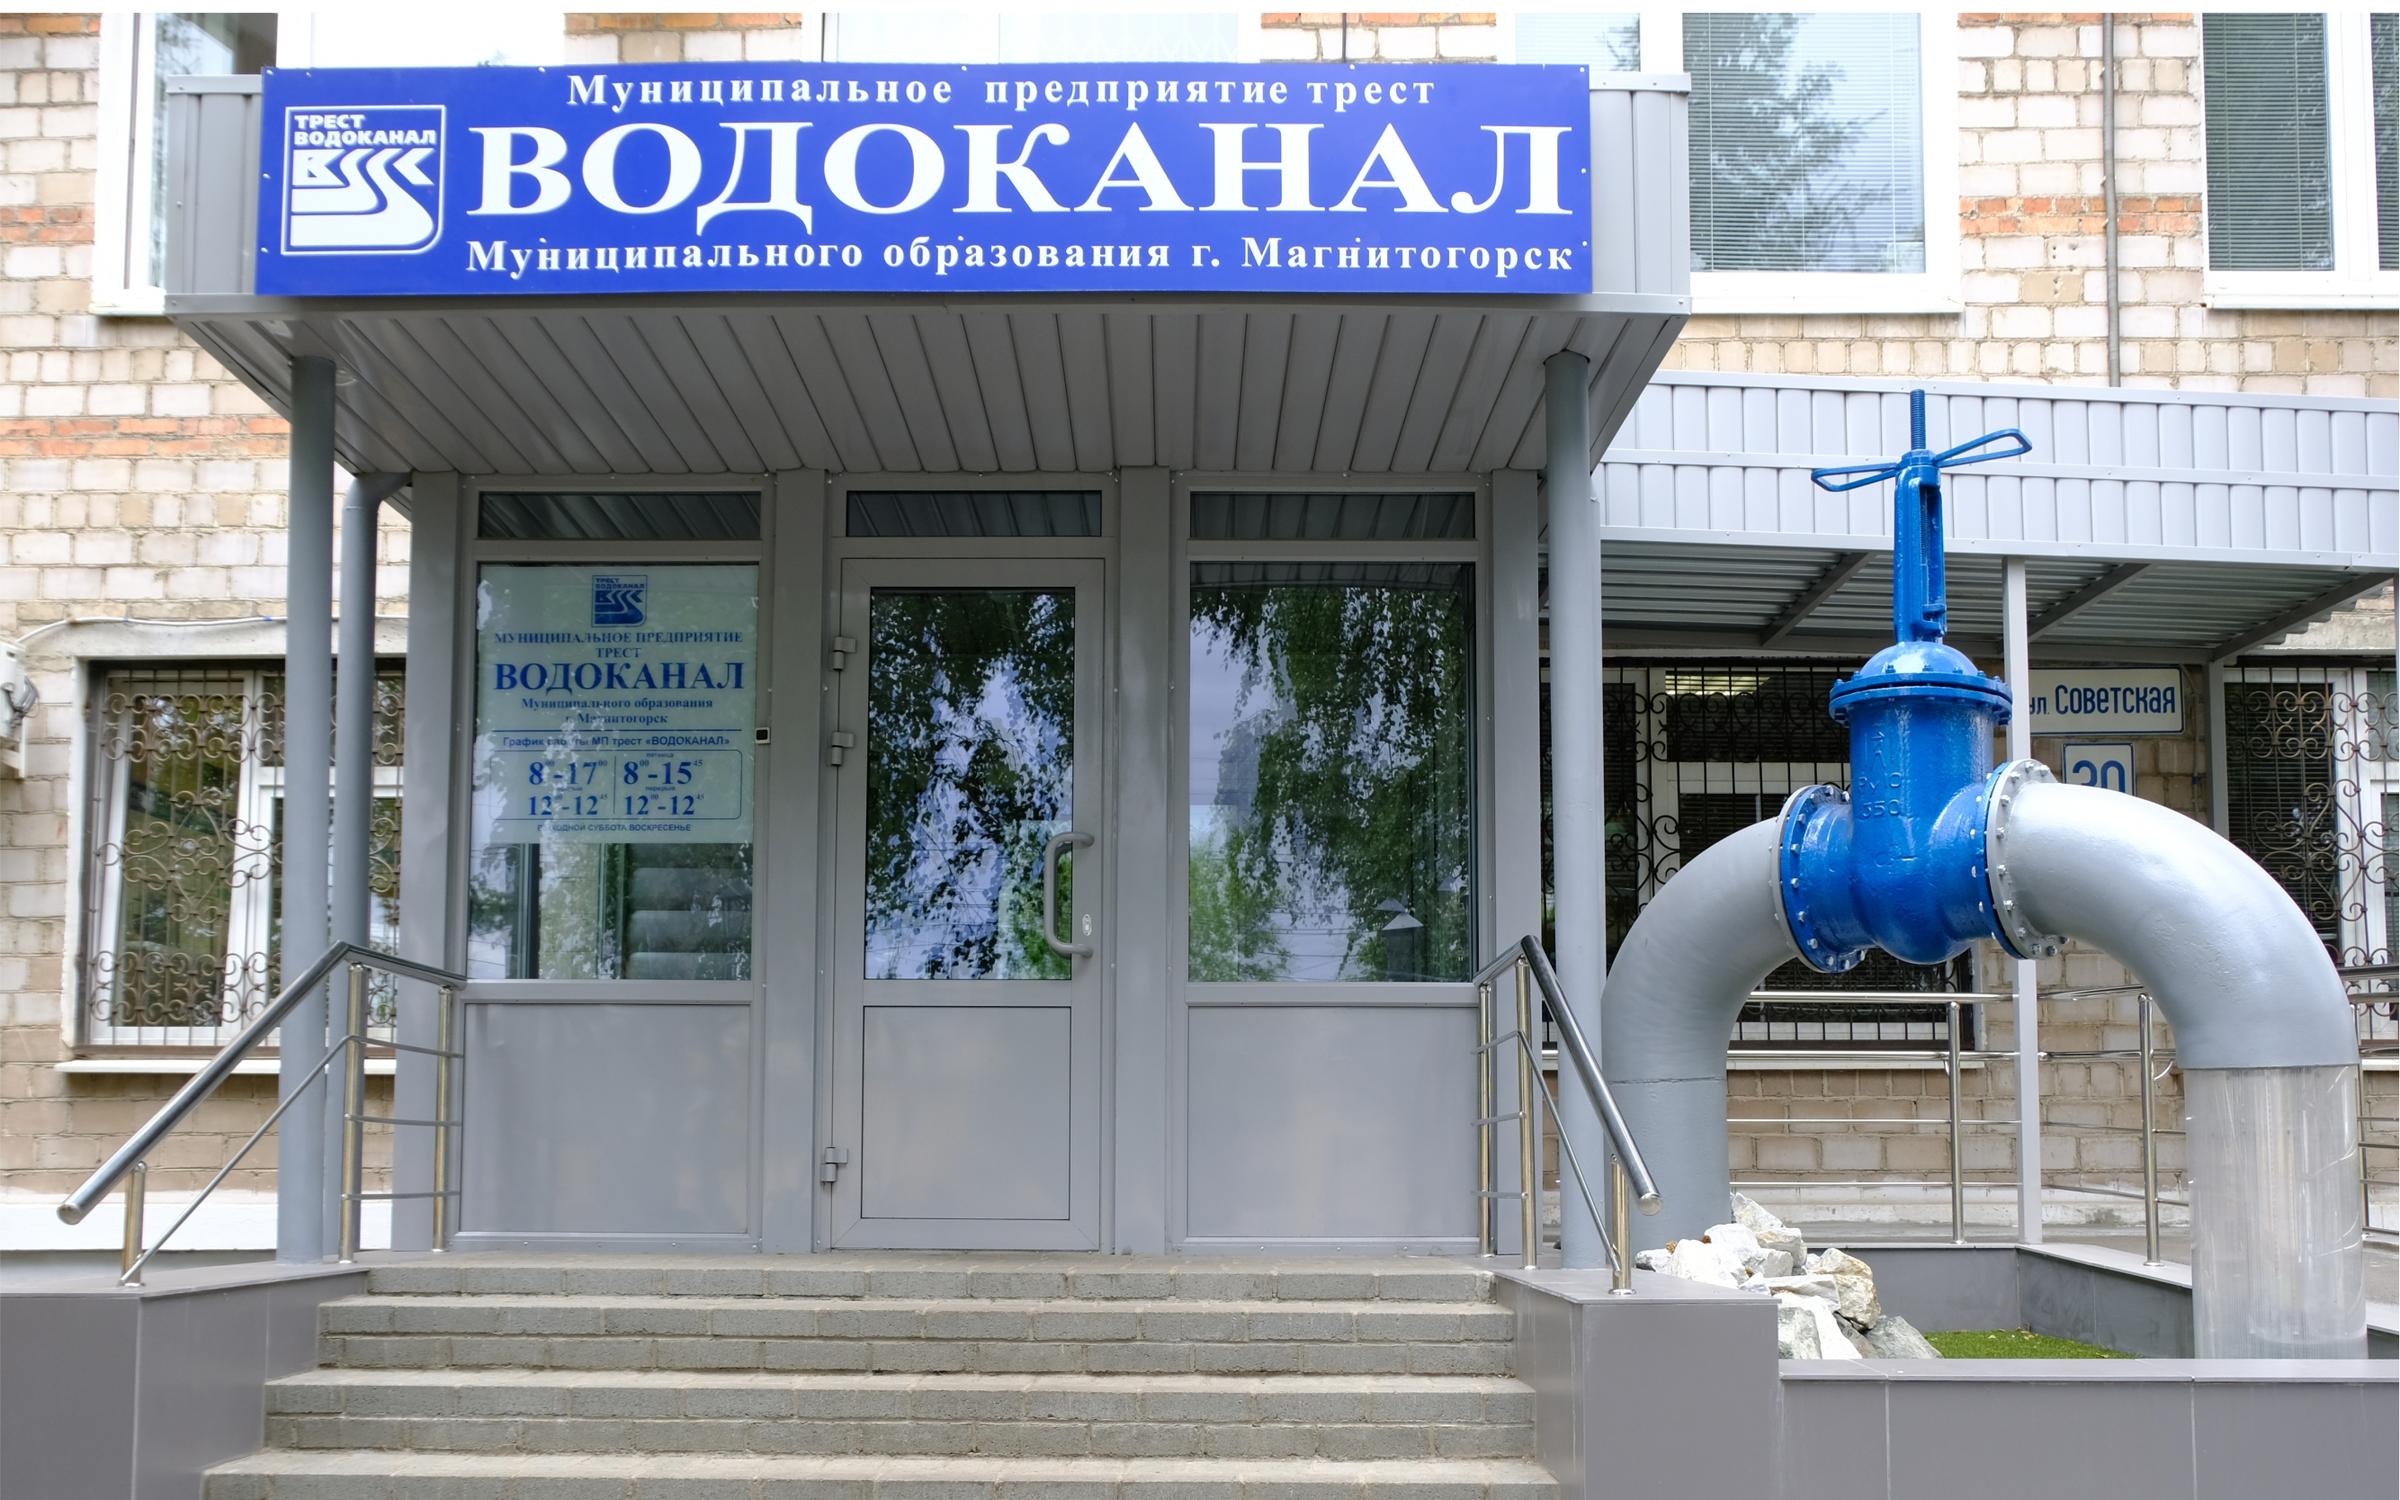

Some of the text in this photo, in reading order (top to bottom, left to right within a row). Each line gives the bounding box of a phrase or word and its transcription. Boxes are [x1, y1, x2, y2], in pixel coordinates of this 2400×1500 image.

[567, 74, 1435, 112] Муниципальное предприятие трест
[294, 114, 366, 128] ТРЕСТ
[294, 130, 437, 147] ВОДОКАНАЛ
[466, 121, 1573, 236] ВОДОКАНАЛ
[467, 237, 1573, 279] Муниципального образования г. Магнитогорск
[495, 632, 743, 645] МУНИЦИПАЛЬНОЕ ПРЕДПРИЯТИЕ
[596, 647, 641, 658] ТРЕСТ
[494, 661, 745, 694] ВОДОКАНАЛ
[634, 697, 713, 711] образования
[2055, 684, 2176, 715] Советская
[503, 736, 545, 749] График
[612, 738, 642, 749] трест
[645, 736, 730, 747] «ВОДОКАНАЛ»
[588, 823, 627, 832] СУББОТА
[629, 823, 691, 832] ВОСКРЕСЕНЬЕ
